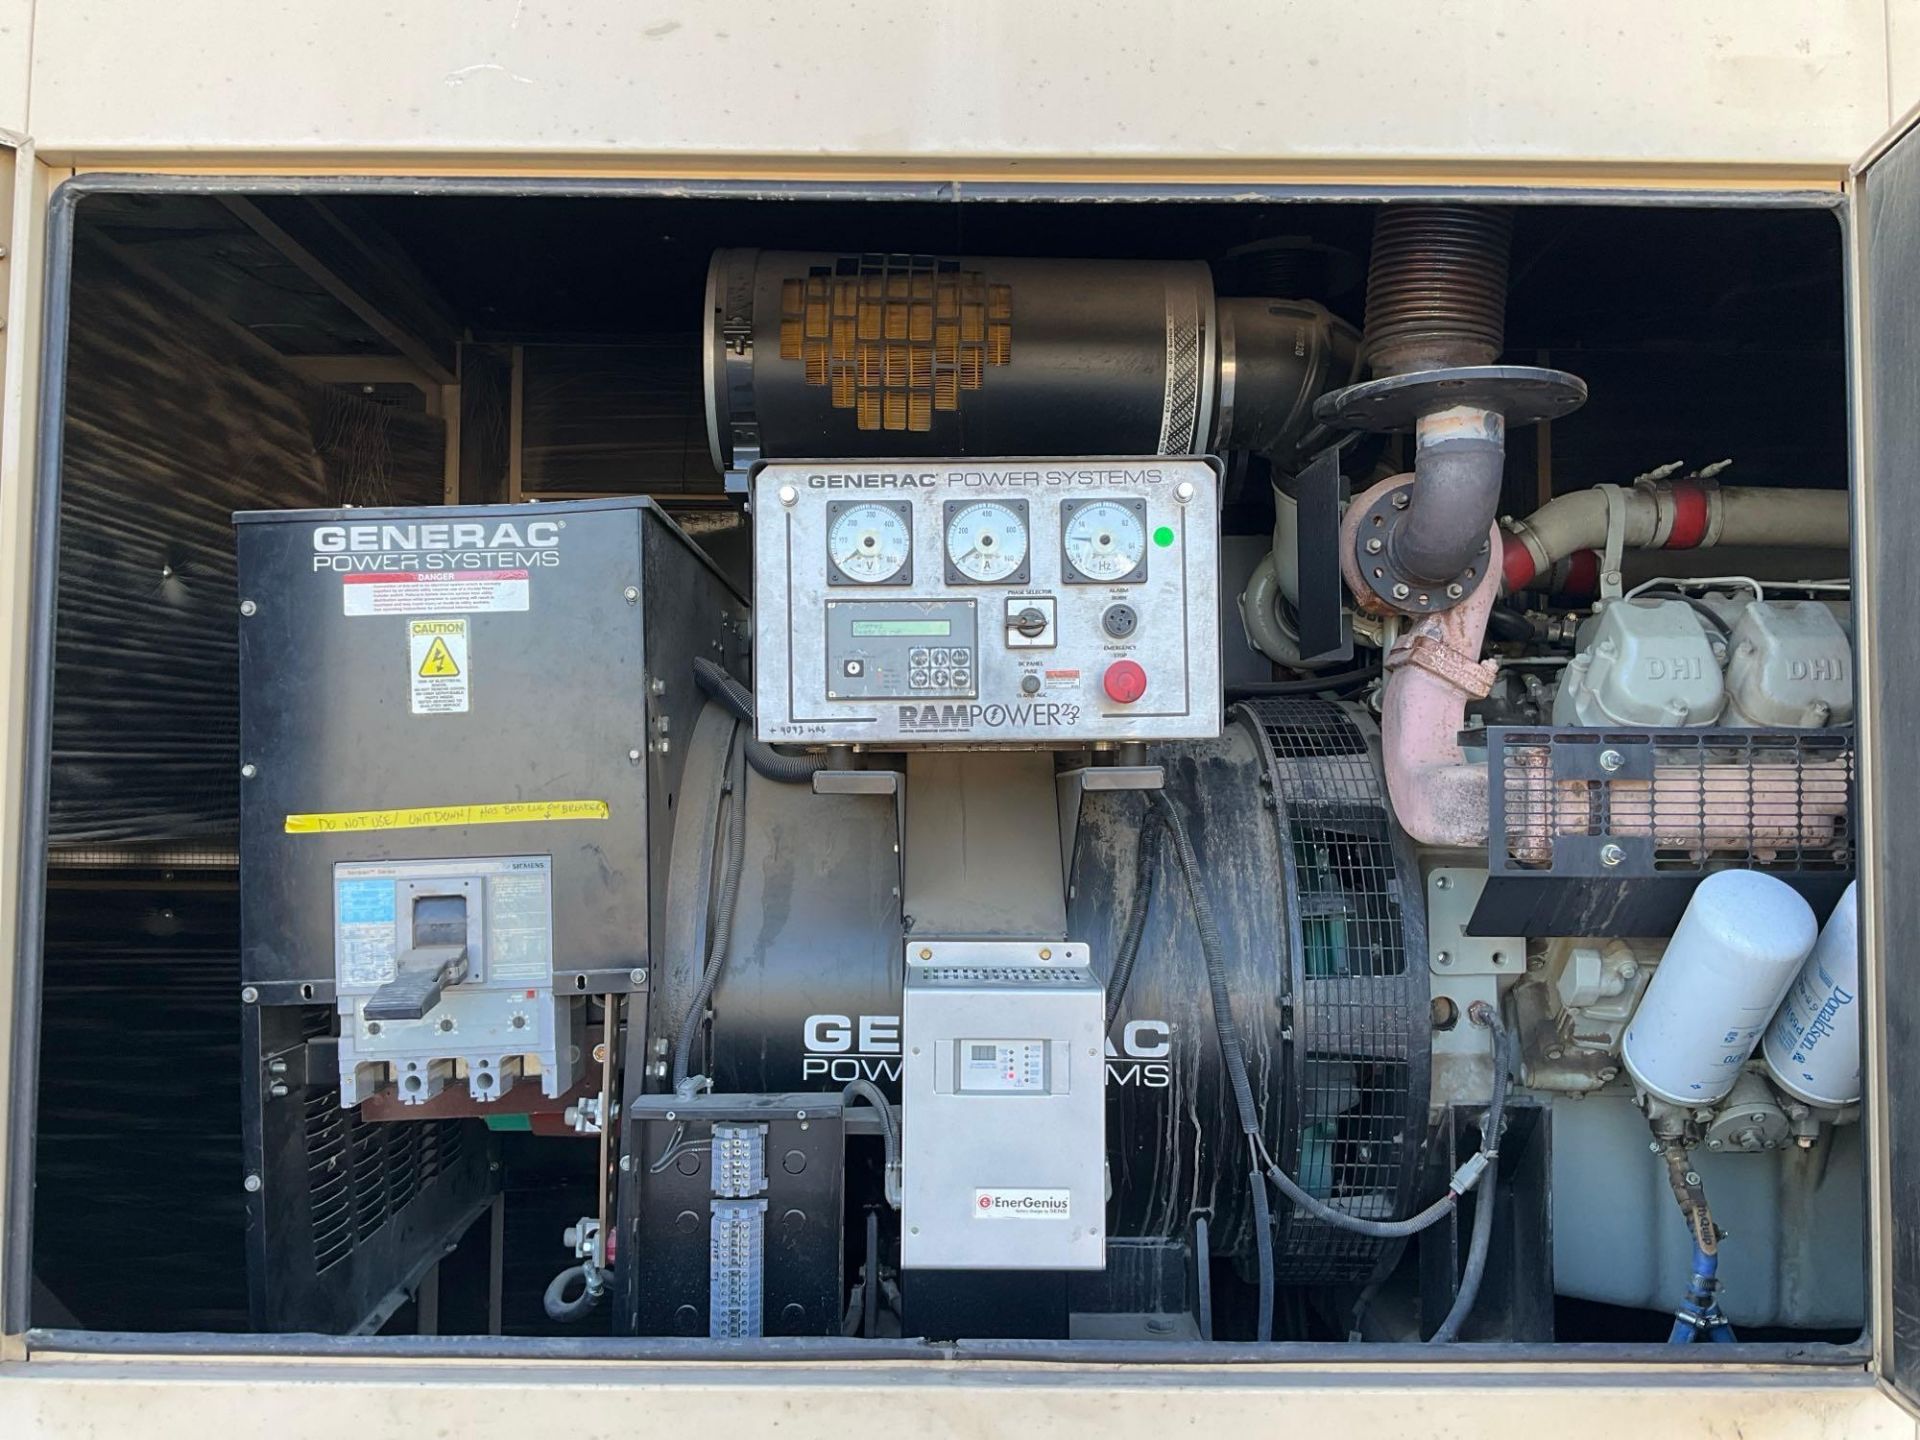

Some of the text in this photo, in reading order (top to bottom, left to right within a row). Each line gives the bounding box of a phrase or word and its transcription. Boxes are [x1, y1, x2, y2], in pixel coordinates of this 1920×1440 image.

[808, 470, 1162, 490] GENERAC POWER SYSTEMS
[313, 522, 559, 550] GENERAC
[313, 551, 560, 572] POWER SYSTEMS
[866, 561, 874, 570] V
[983, 561, 991, 569] A
[1098, 561, 1111, 571] Hz
[417, 573, 455, 582] DANGER
[412, 623, 465, 634] CAUTION
[1647, 657, 1702, 680] DHI
[1786, 658, 1843, 680] DHI
[318, 818, 337, 832] DO
[344, 816, 368, 830] NOT
[512, 862, 545, 870] SIEMENS
[1801, 985, 1854, 1051] Donaldson
[803, 1058, 903, 1082] POW
[994, 1196, 1068, 1209] EnerGenius
